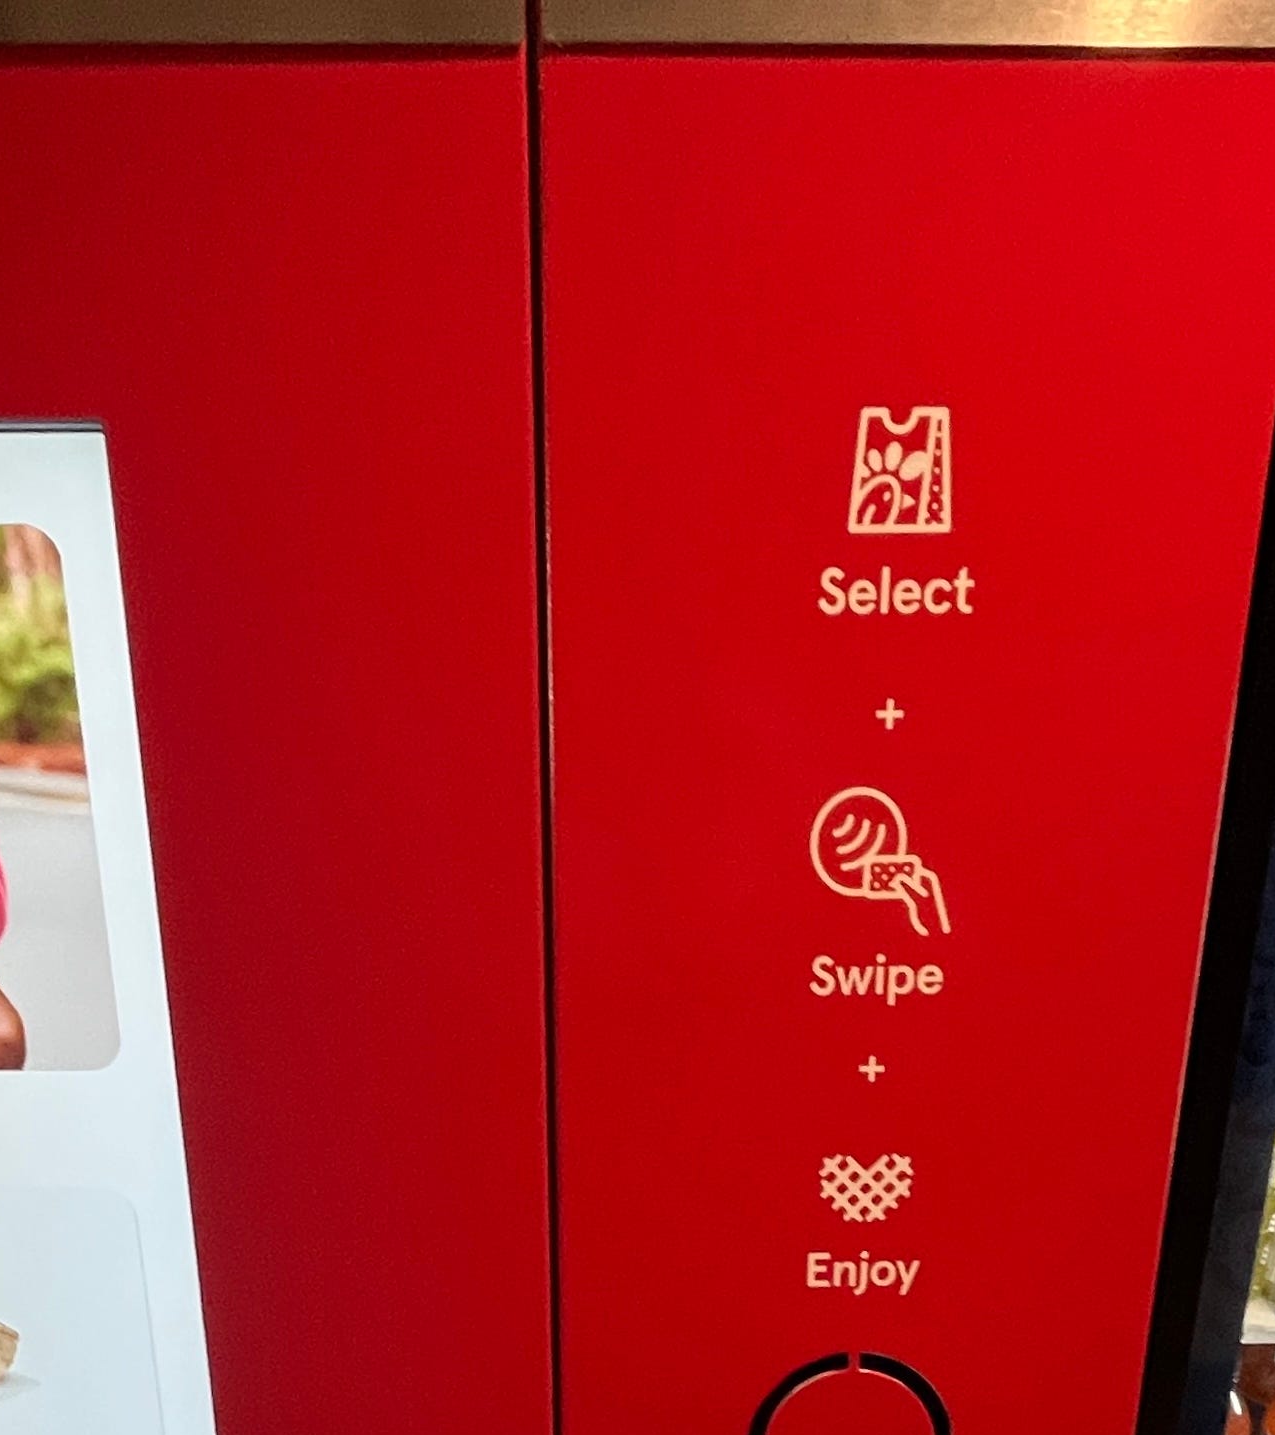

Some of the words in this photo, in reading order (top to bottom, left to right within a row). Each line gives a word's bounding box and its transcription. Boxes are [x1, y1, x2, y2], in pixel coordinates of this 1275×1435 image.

[818, 566, 976, 616] Select
[810, 954, 946, 1008] Swipe
[807, 1251, 922, 1297] Enjoy
